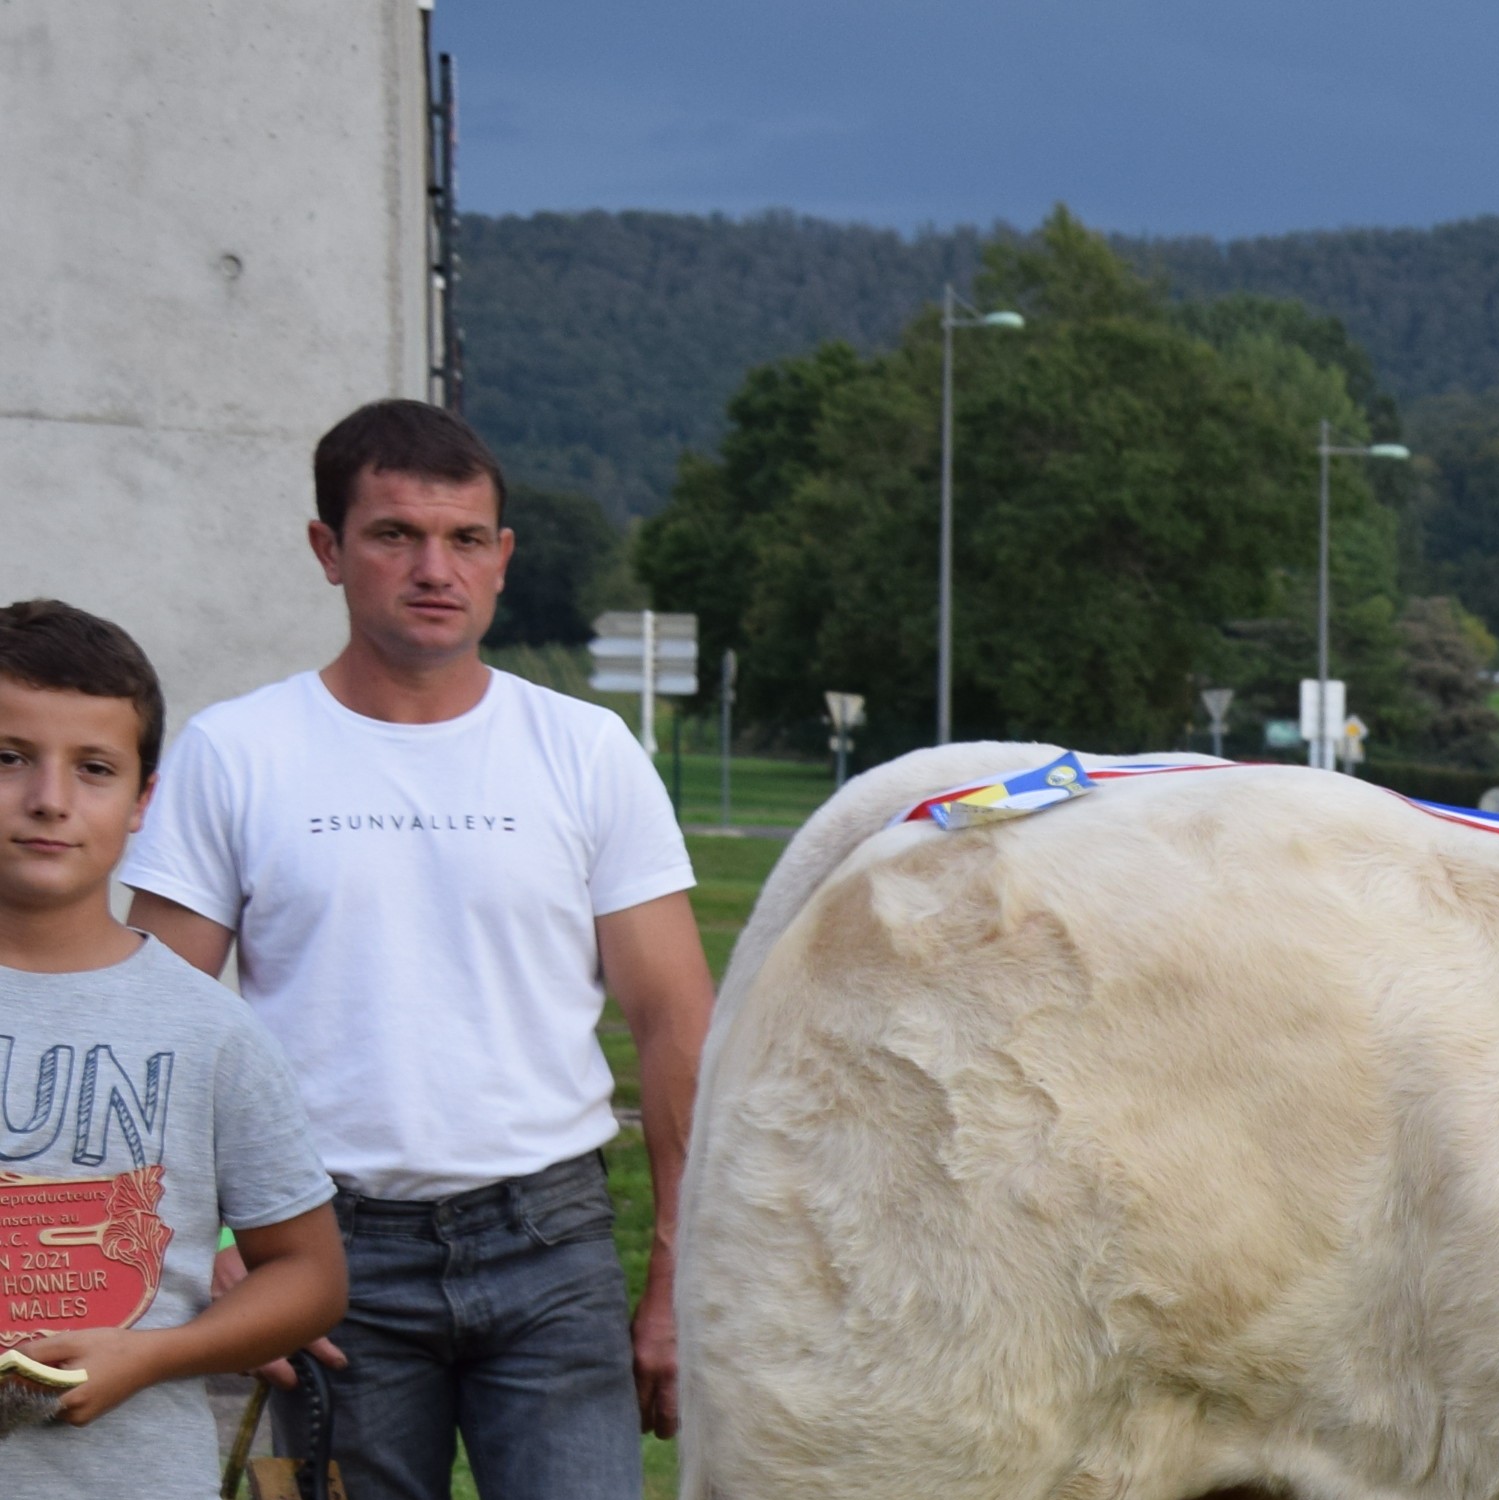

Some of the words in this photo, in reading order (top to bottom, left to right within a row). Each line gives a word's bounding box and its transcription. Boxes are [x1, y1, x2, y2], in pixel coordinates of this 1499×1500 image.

[60, 1213, 79, 1223] au
[22, 1252, 71, 1270] 2021
[4, 1270, 108, 1296] HONNEUR
[11, 1295, 88, 1321] MÂLES
